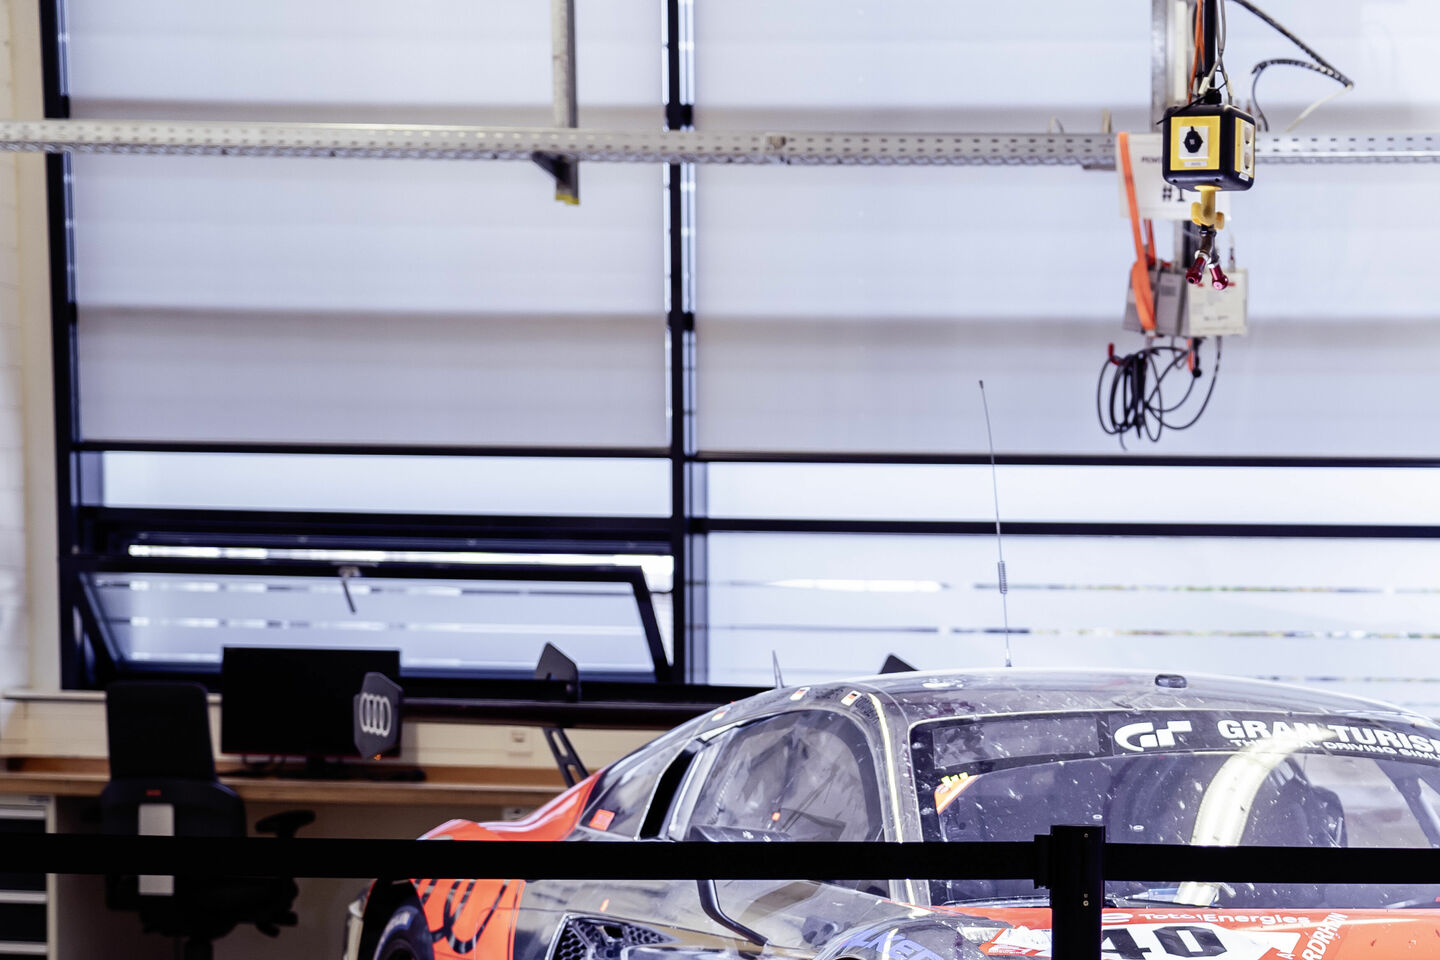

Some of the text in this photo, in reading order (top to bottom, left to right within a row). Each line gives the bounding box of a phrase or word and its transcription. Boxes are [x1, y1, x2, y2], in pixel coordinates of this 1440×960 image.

[1217, 719, 1320, 742] GRAN
[1322, 742, 1397, 754] DRIVING
[1101, 926, 1228, 960] 40
